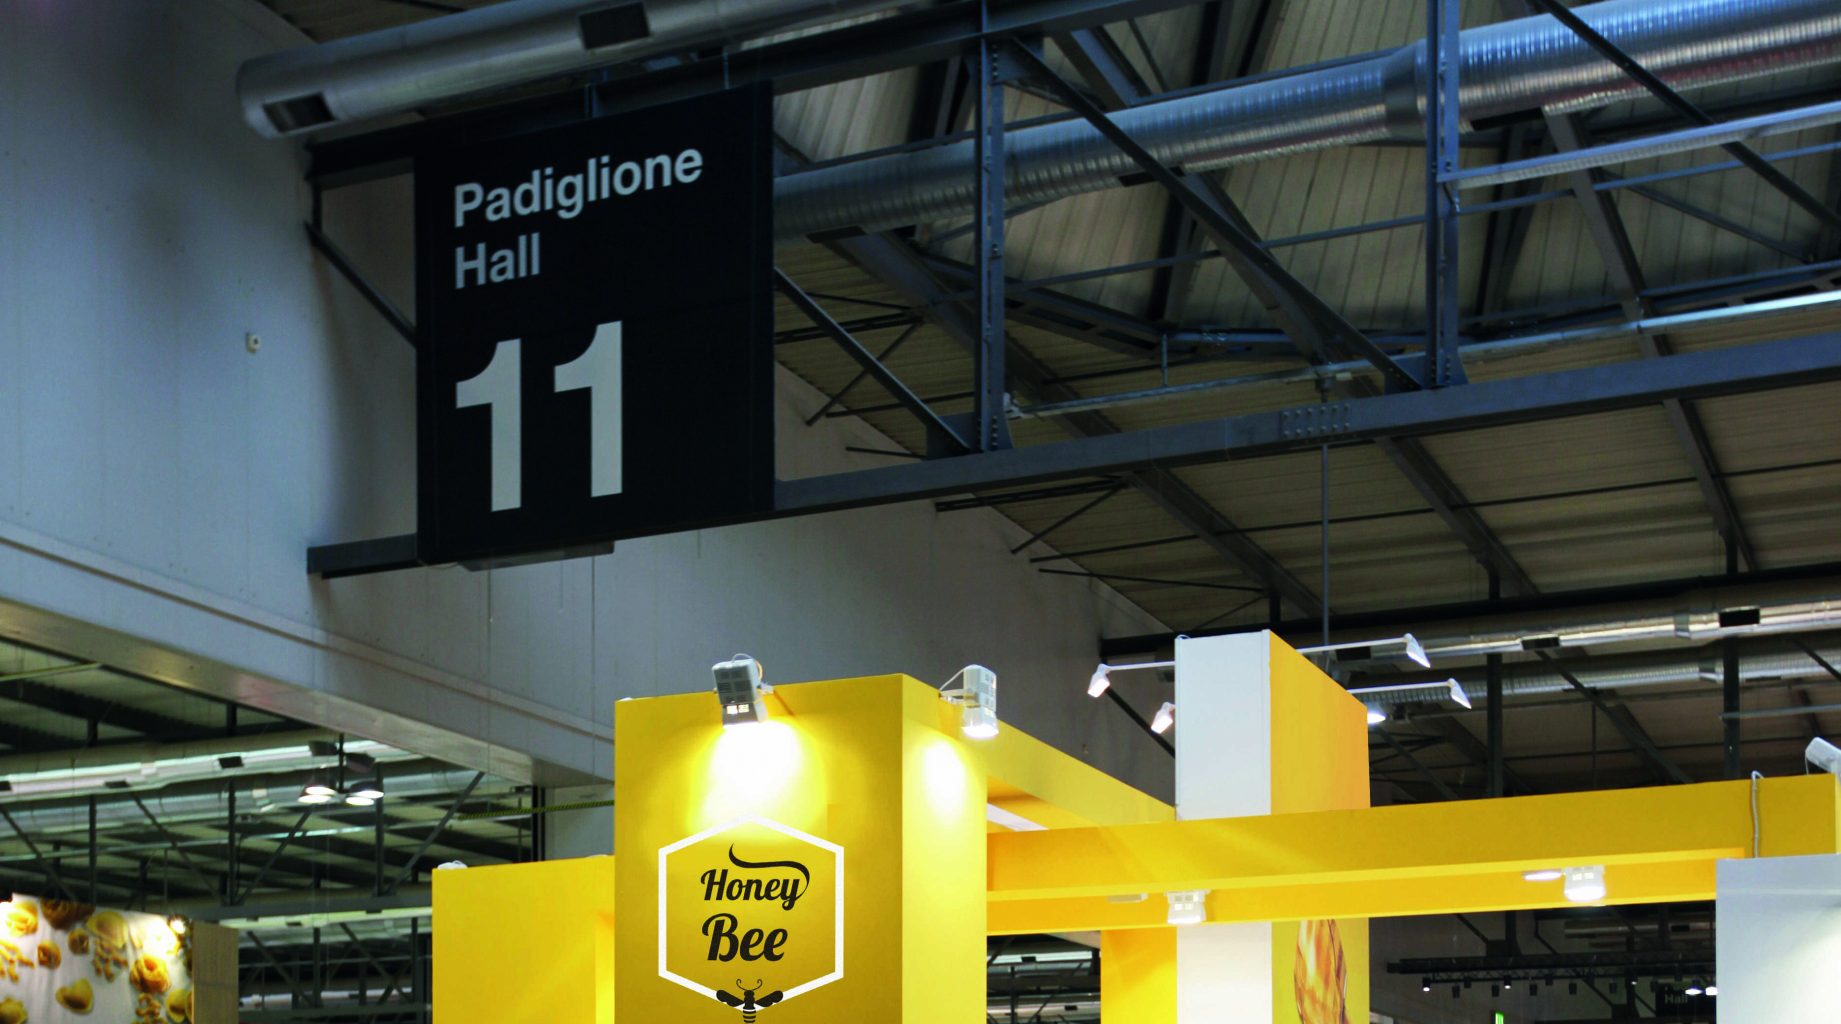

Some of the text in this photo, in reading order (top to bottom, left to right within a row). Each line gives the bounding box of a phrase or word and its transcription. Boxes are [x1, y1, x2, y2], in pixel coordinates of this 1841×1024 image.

[454, 148, 703, 228] Padiglione
[455, 232, 541, 289] Hall
[456, 320, 623, 512] 11
[700, 842, 811, 911] Honey
[701, 912, 788, 963] Bee
